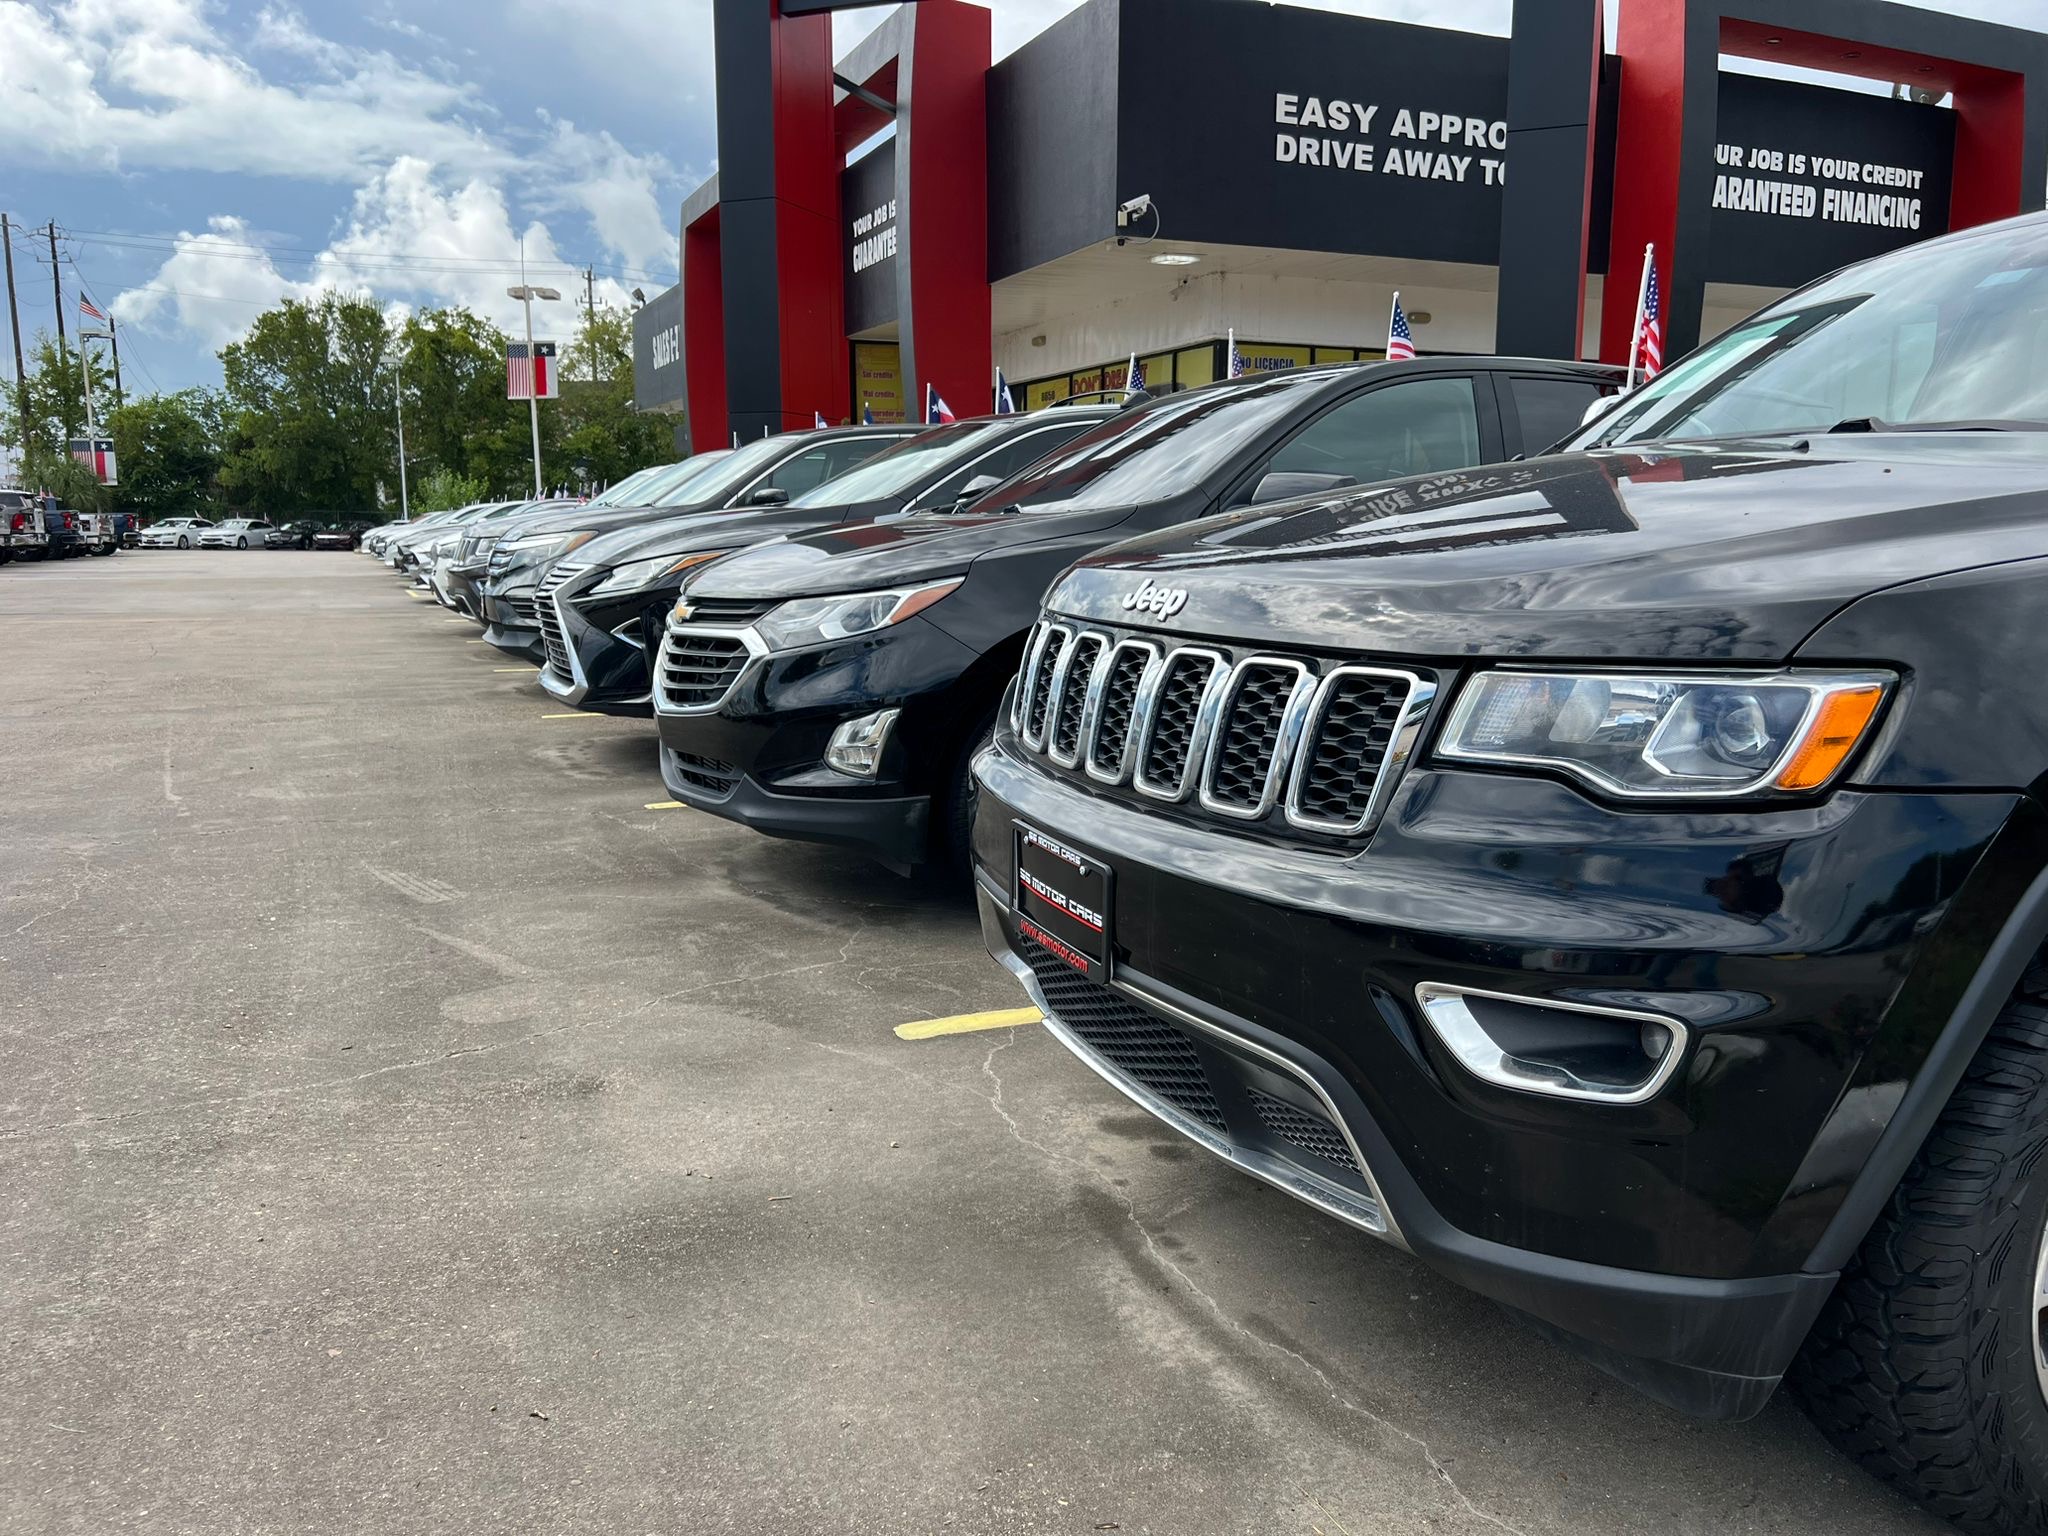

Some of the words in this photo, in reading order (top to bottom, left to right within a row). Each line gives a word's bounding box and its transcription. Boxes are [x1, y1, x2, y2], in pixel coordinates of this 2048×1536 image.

[1275, 93, 1378, 134] EASY
[1390, 109, 1507, 150] APPRO
[1275, 134, 1374, 172] DRIVE
[1382, 148, 1473, 182] AWAY
[1714, 143, 1743, 167] UR
[1748, 148, 1783, 172] JOB
[1788, 153, 1806, 175] IS
[1811, 156, 1860, 182] YOUR
[1862, 163, 1923, 190] CREDIT
[853, 213, 872, 238] YOUR
[873, 204, 888, 228] JOB
[888, 200, 896, 219] IS
[1711, 174, 1817, 218] ARANTEED
[1822, 188, 1922, 230] FINANCING
[652, 329, 670, 370] SALES
[1255, 357, 1294, 370] LICENCIA
[1103, 367, 1128, 389] DREA
[1122, 578, 1188, 622] Jeep
[1037, 836, 1060, 855] MOTOR
[1061, 848, 1081, 866] CARS
[1020, 868, 1031, 885] SS
[1032, 877, 1067, 908] MOTOR
[1069, 899, 1103, 928] CARS
